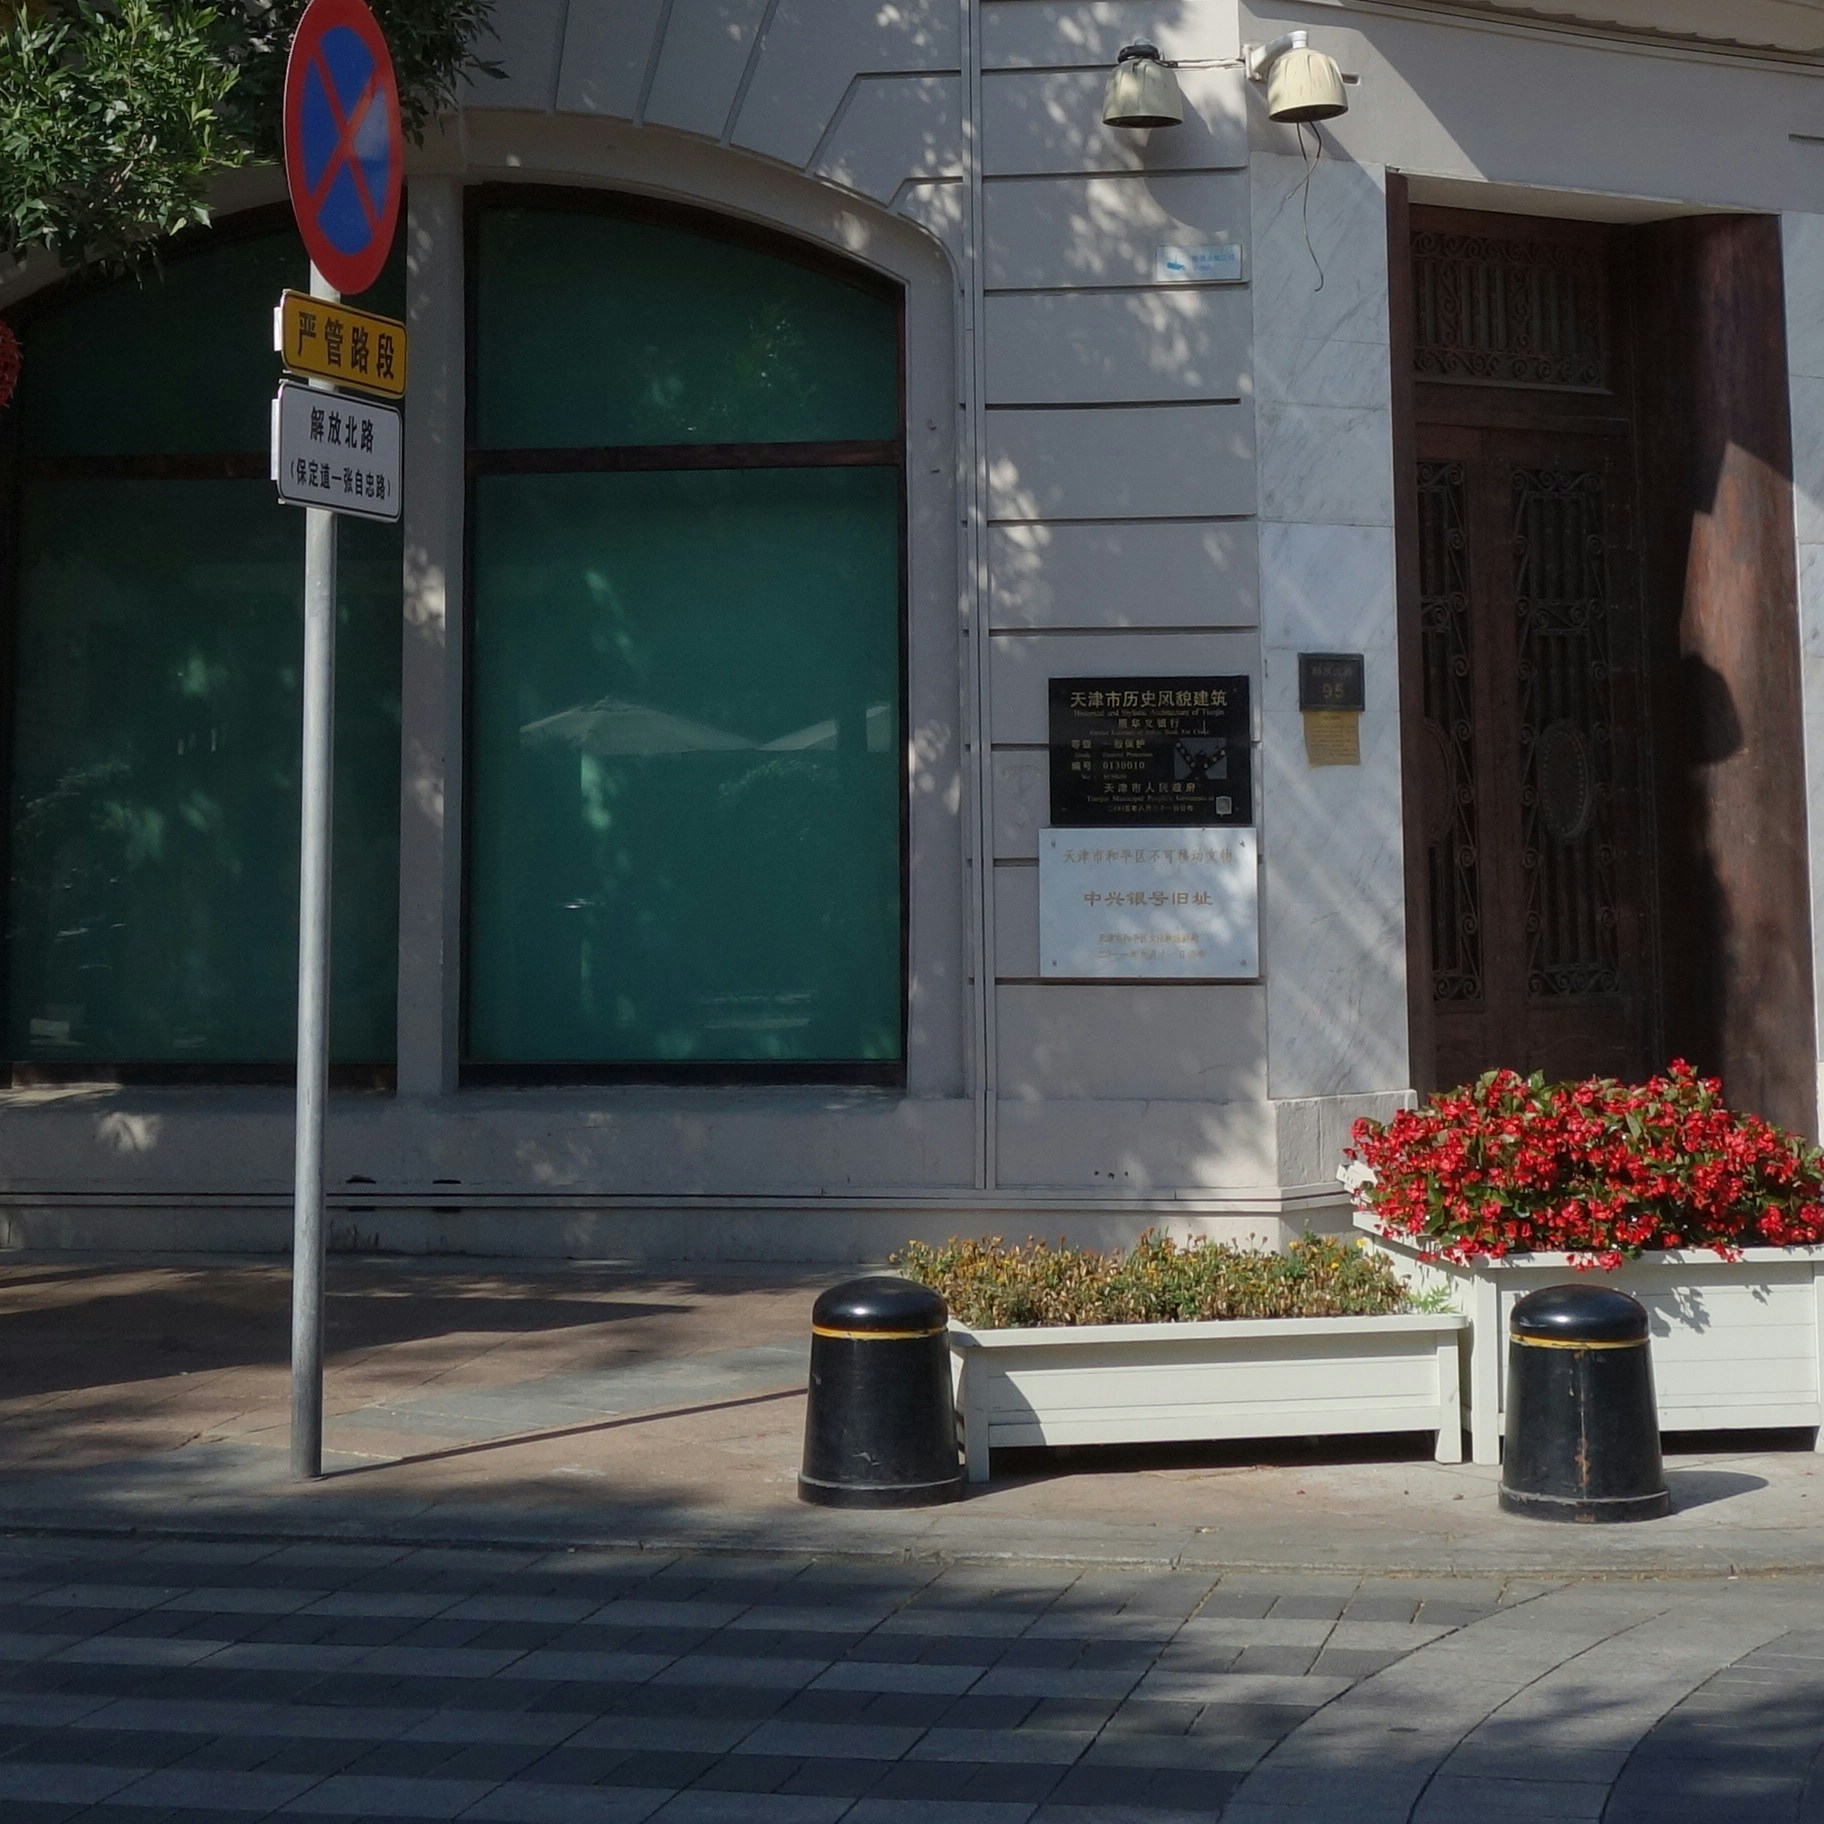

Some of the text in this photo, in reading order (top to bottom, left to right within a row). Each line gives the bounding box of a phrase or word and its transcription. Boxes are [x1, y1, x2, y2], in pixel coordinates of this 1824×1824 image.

[298, 311, 394, 379] 严管路段
[309, 406, 374, 453] 解放北路
[1070, 689, 1228, 708] 天津市历史风貌建筑
[1104, 782, 1197, 793] 天津市人民政府
[1063, 848, 1234, 864] 天津市和平区不可移动文物
[1084, 891, 1214, 907] 中兴银号旧址
